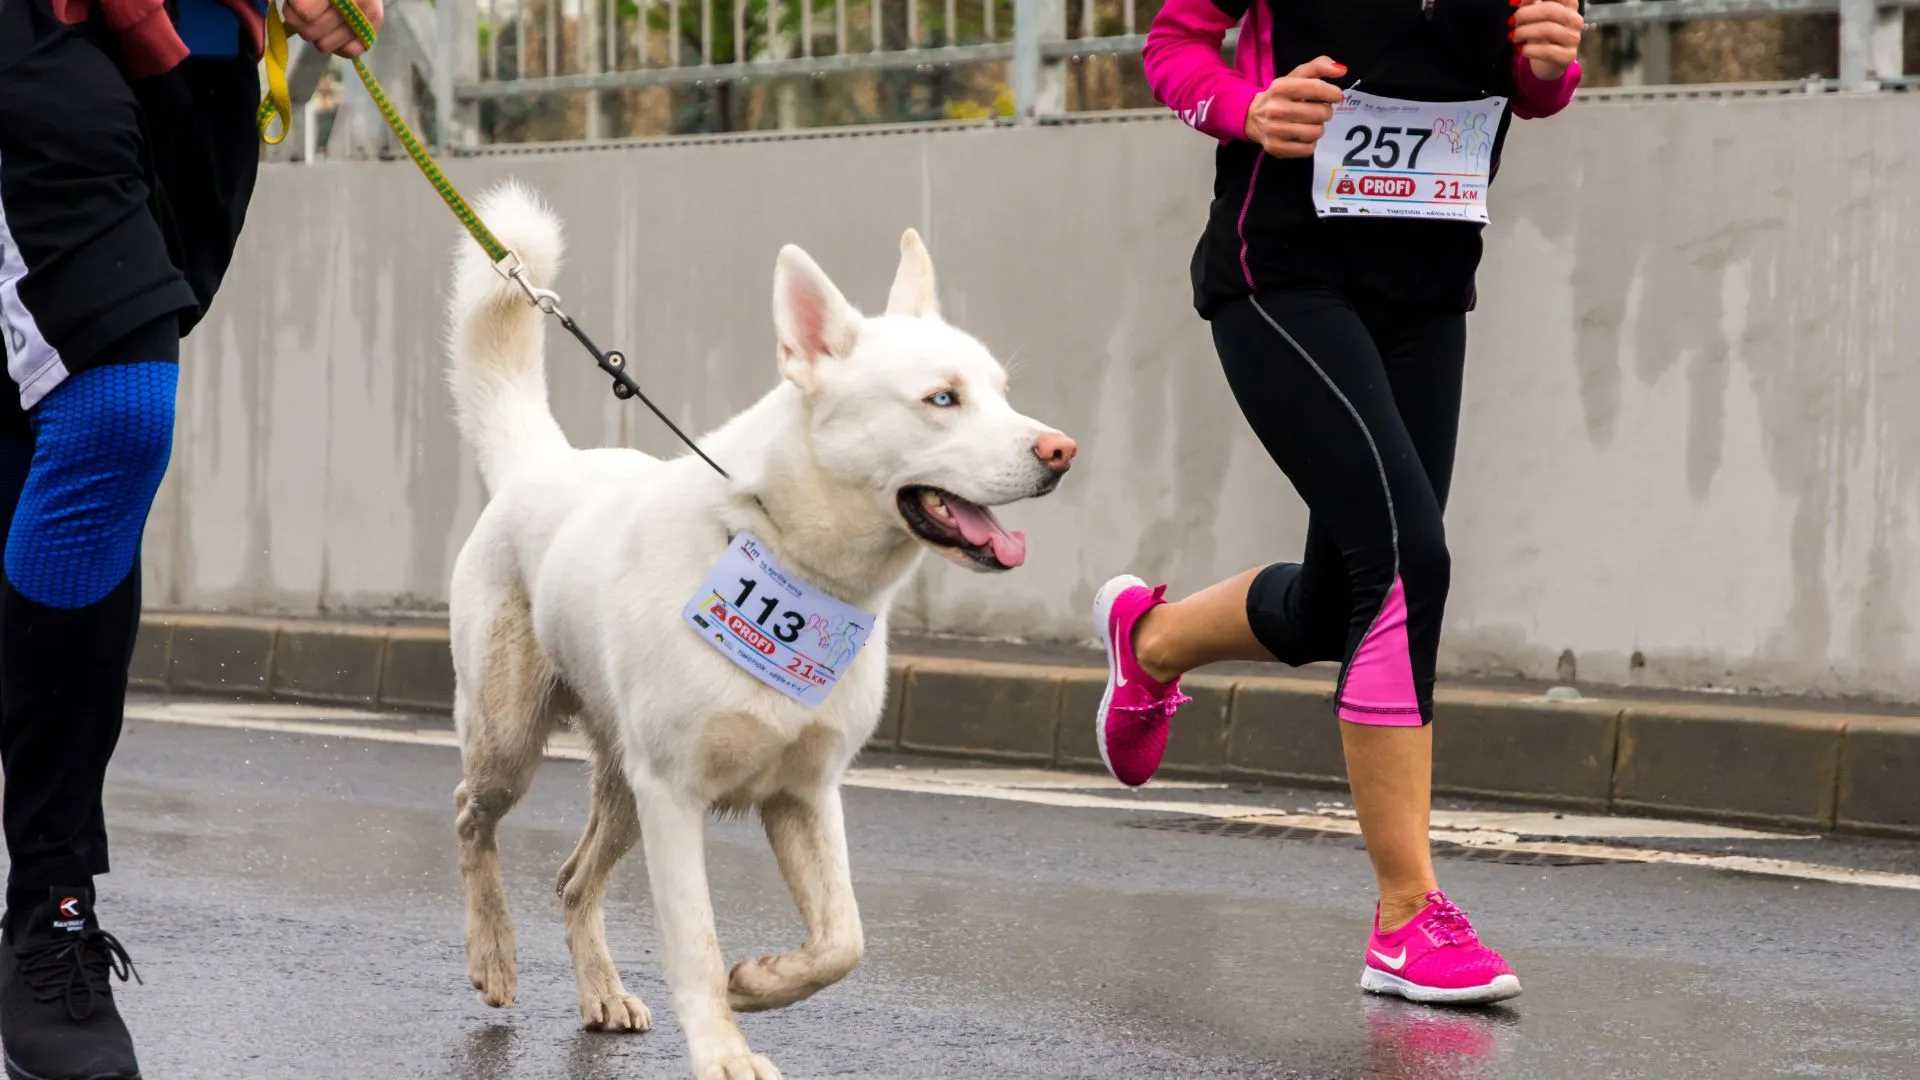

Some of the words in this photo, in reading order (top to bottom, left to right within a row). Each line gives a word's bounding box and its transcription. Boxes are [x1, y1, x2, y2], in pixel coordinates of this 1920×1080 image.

[1342, 125, 1432, 169] 257
[1363, 178, 1411, 195] PROFI
[1433, 180, 1462, 200] 21
[1462, 191, 1478, 200] KM
[734, 577, 806, 643] 113
[731, 618, 771, 654] PROFI
[786, 657, 814, 679] 21
[811, 674, 826, 685] KM
